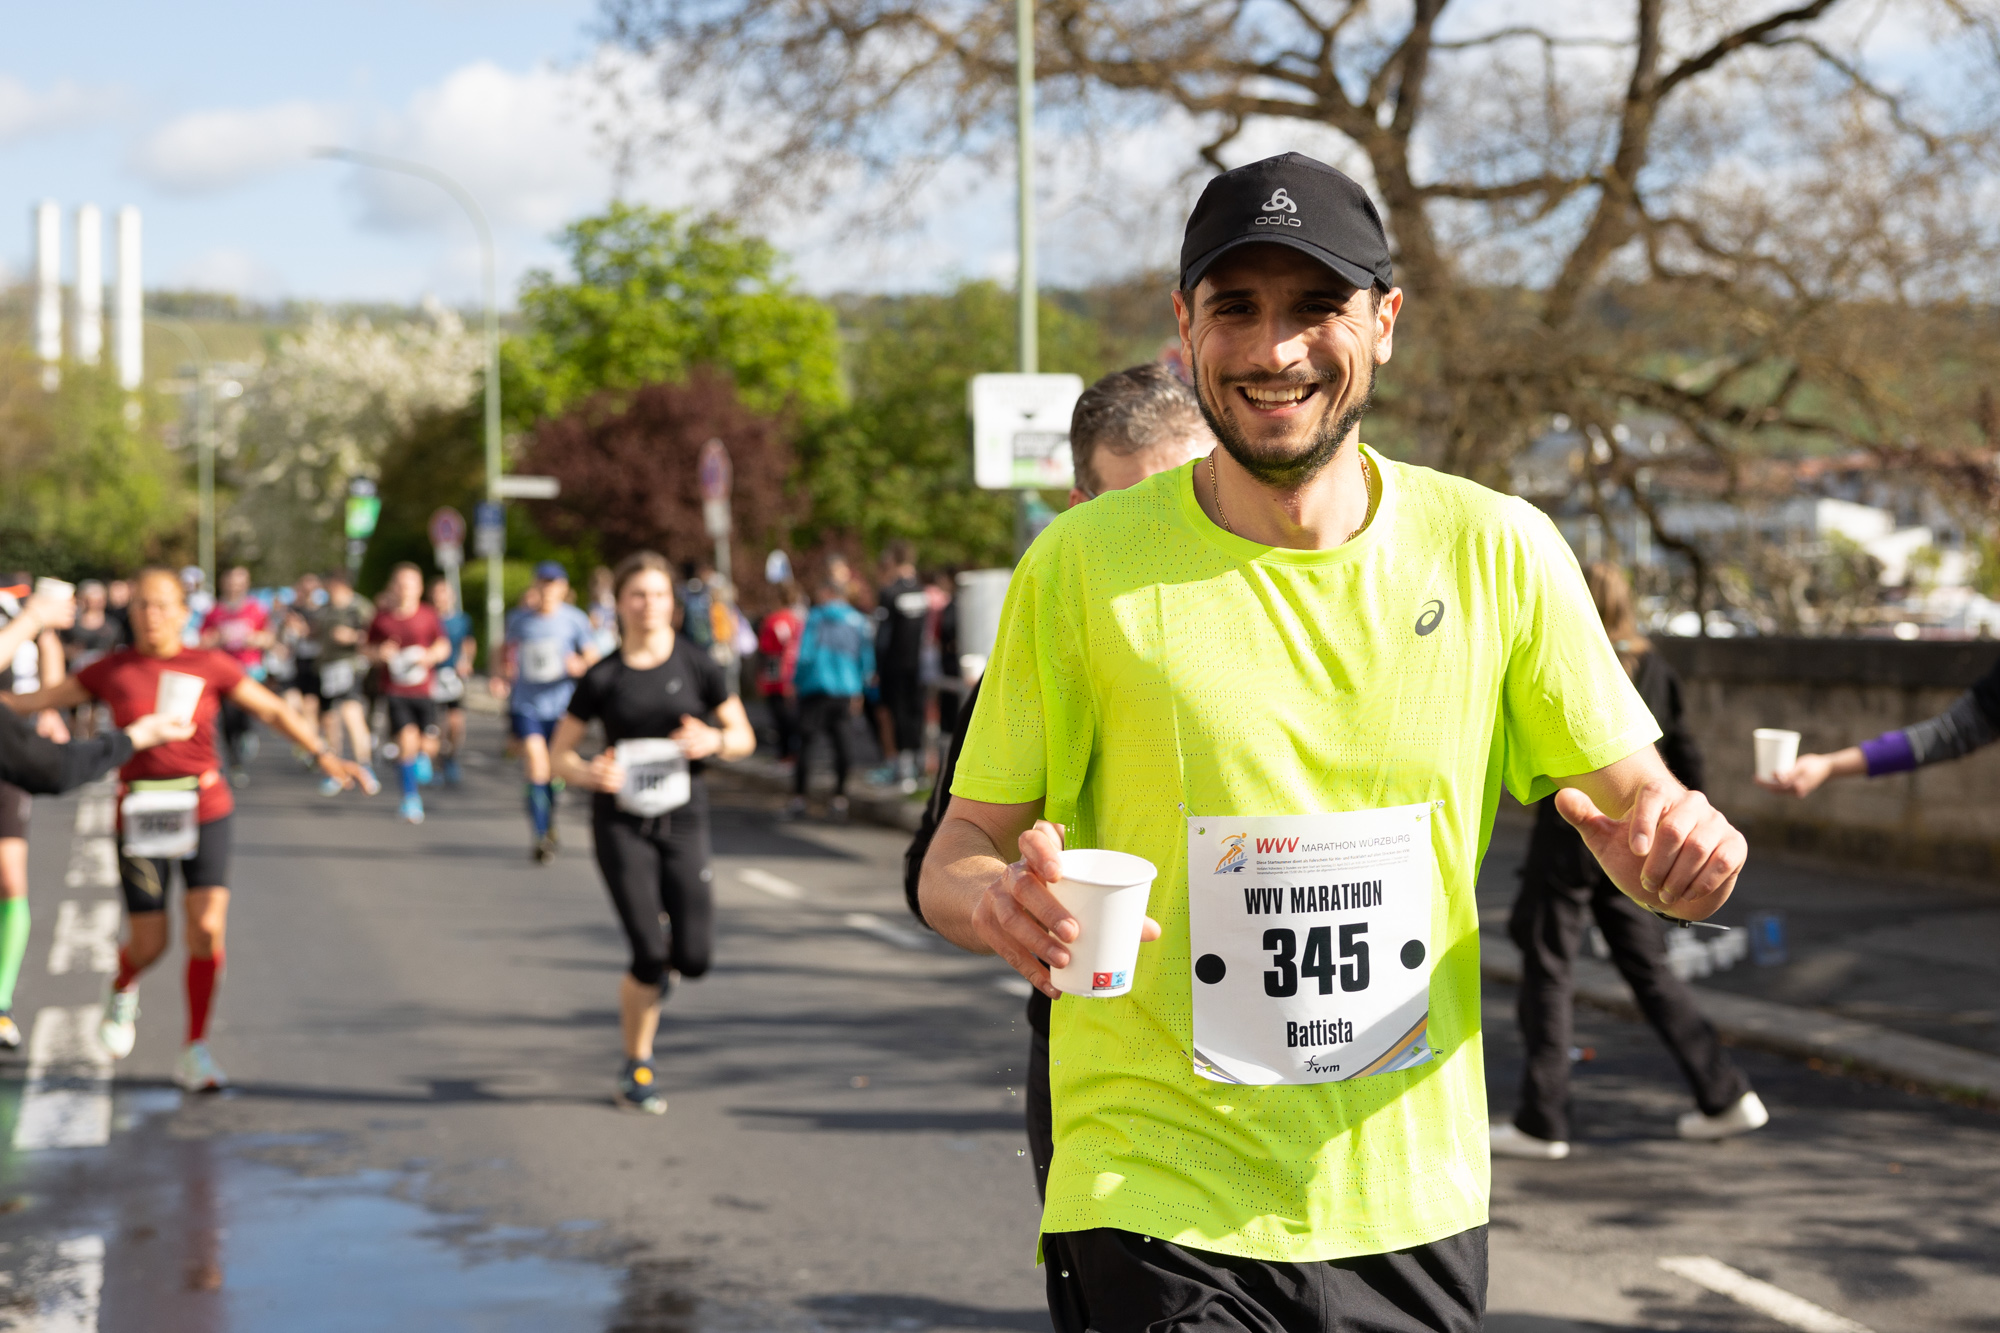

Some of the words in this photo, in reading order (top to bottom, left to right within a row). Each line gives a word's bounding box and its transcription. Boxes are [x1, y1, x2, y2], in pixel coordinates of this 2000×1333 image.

[1255, 214, 1302, 228] odlo
[1256, 836, 1300, 854] WVV
[1301, 841, 1357, 852] MARATHON
[1359, 834, 1411, 848] WÜRZBURG
[1244, 887, 1284, 915] WVV
[1290, 879, 1382, 914] MARATHON
[1262, 921, 1370, 998] 345
[1286, 1017, 1353, 1048] Battista
